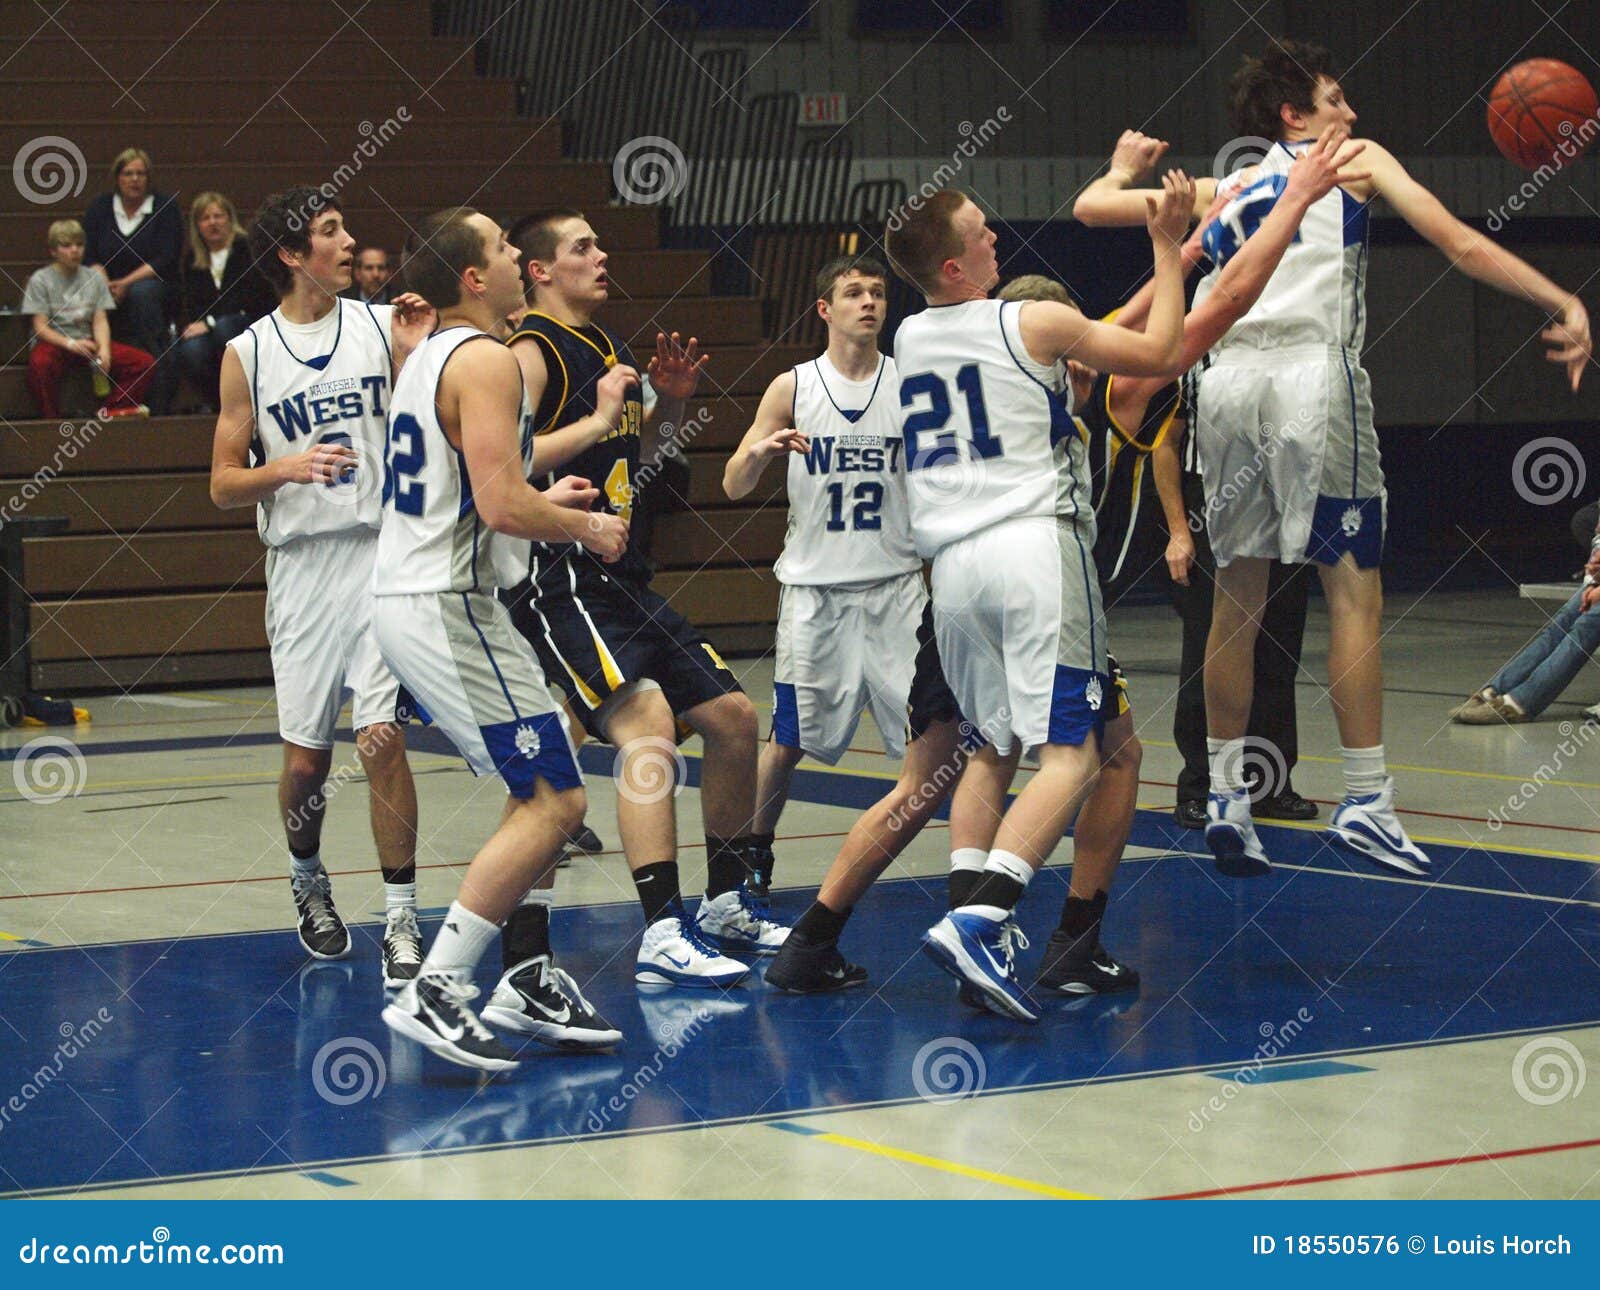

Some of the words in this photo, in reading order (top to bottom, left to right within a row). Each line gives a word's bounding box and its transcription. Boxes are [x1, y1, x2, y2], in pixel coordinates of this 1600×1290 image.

[803, 94, 841, 122] EXIT
[309, 377, 357, 397] WAUKESHA
[266, 375, 387, 442] WEST
[899, 362, 1004, 473] 21
[803, 436, 903, 476] WEST
[838, 434, 881, 447] WAUKESHA
[826, 481, 884, 531] 12
